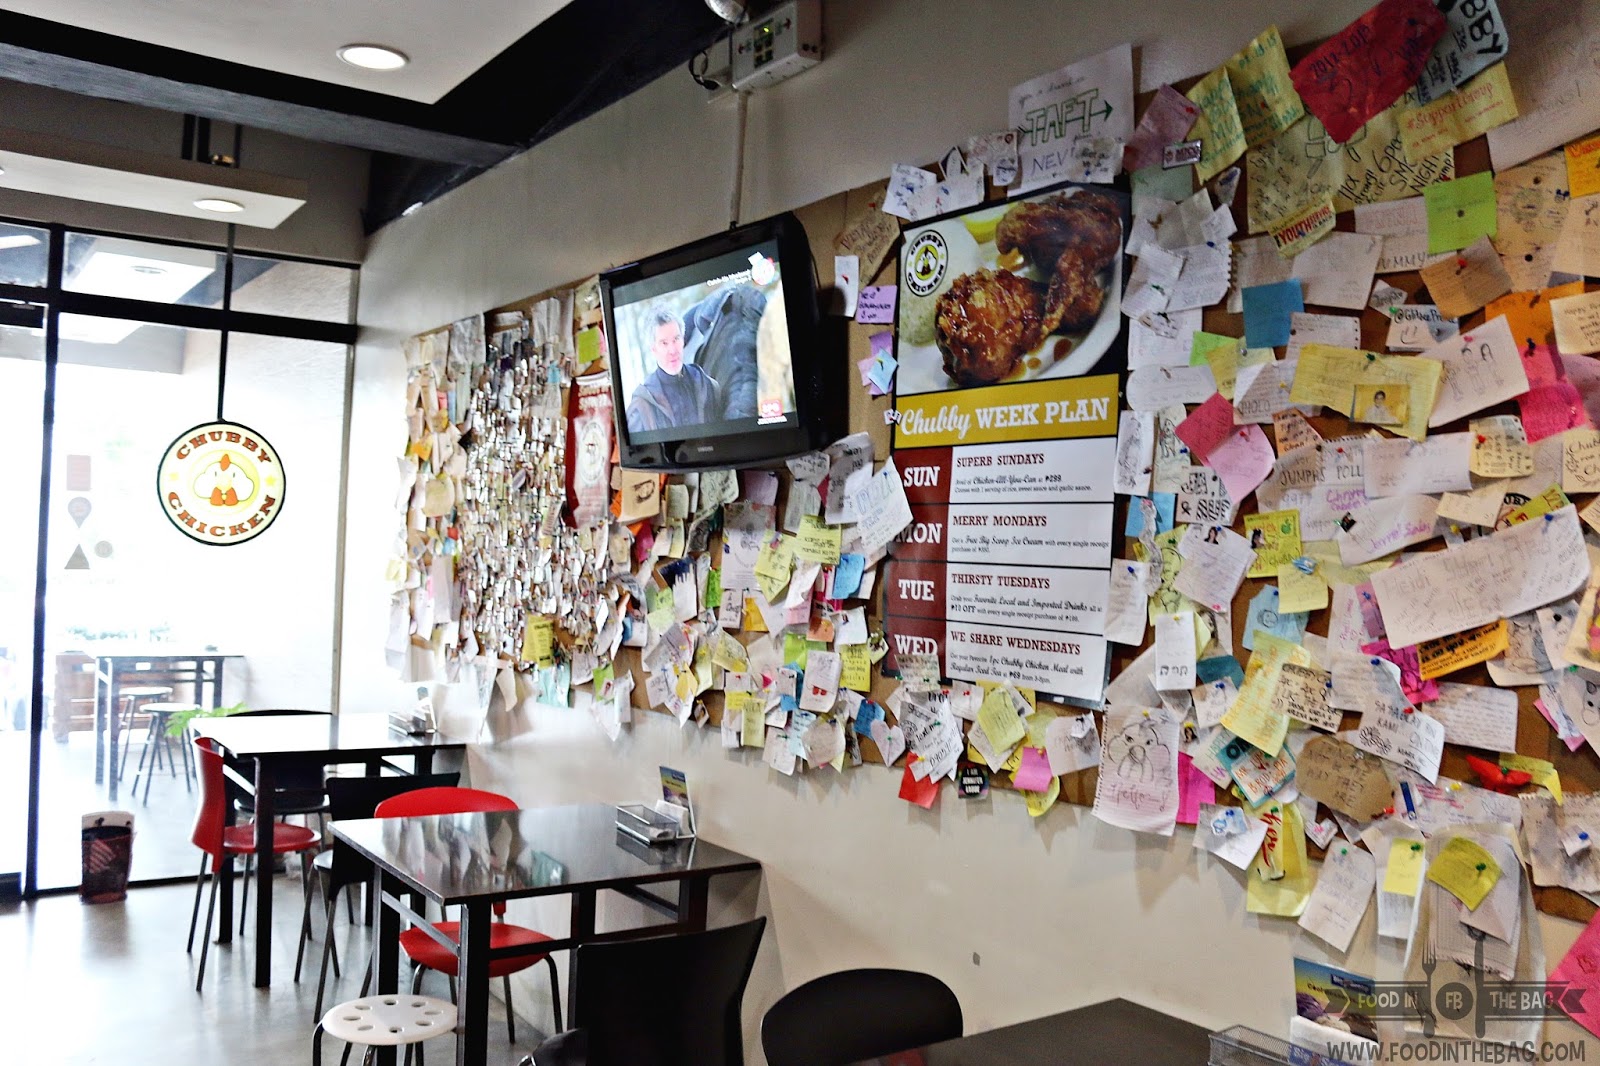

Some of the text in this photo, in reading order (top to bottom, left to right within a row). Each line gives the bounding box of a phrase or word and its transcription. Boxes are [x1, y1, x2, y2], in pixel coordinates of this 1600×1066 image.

[1025, 88, 1099, 147] TAFT
[901, 397, 1110, 439] Chubby WEEK PLAN
[176, 431, 272, 463] CHUBBY
[956, 453, 1045, 468] SUPERB SUNDAYS
[903, 466, 941, 488] SUN
[168, 491, 276, 537] CHICKEN
[952, 515, 1047, 527] MERRY MONDAYS
[898, 523, 943, 544] MON
[898, 579, 935, 601] TUE
[951, 573, 1050, 589] THIRSTY TUESDAYS
[894, 634, 938, 656] WED
[950, 630, 1081, 655] WE SHARE WEDNESDAYS
